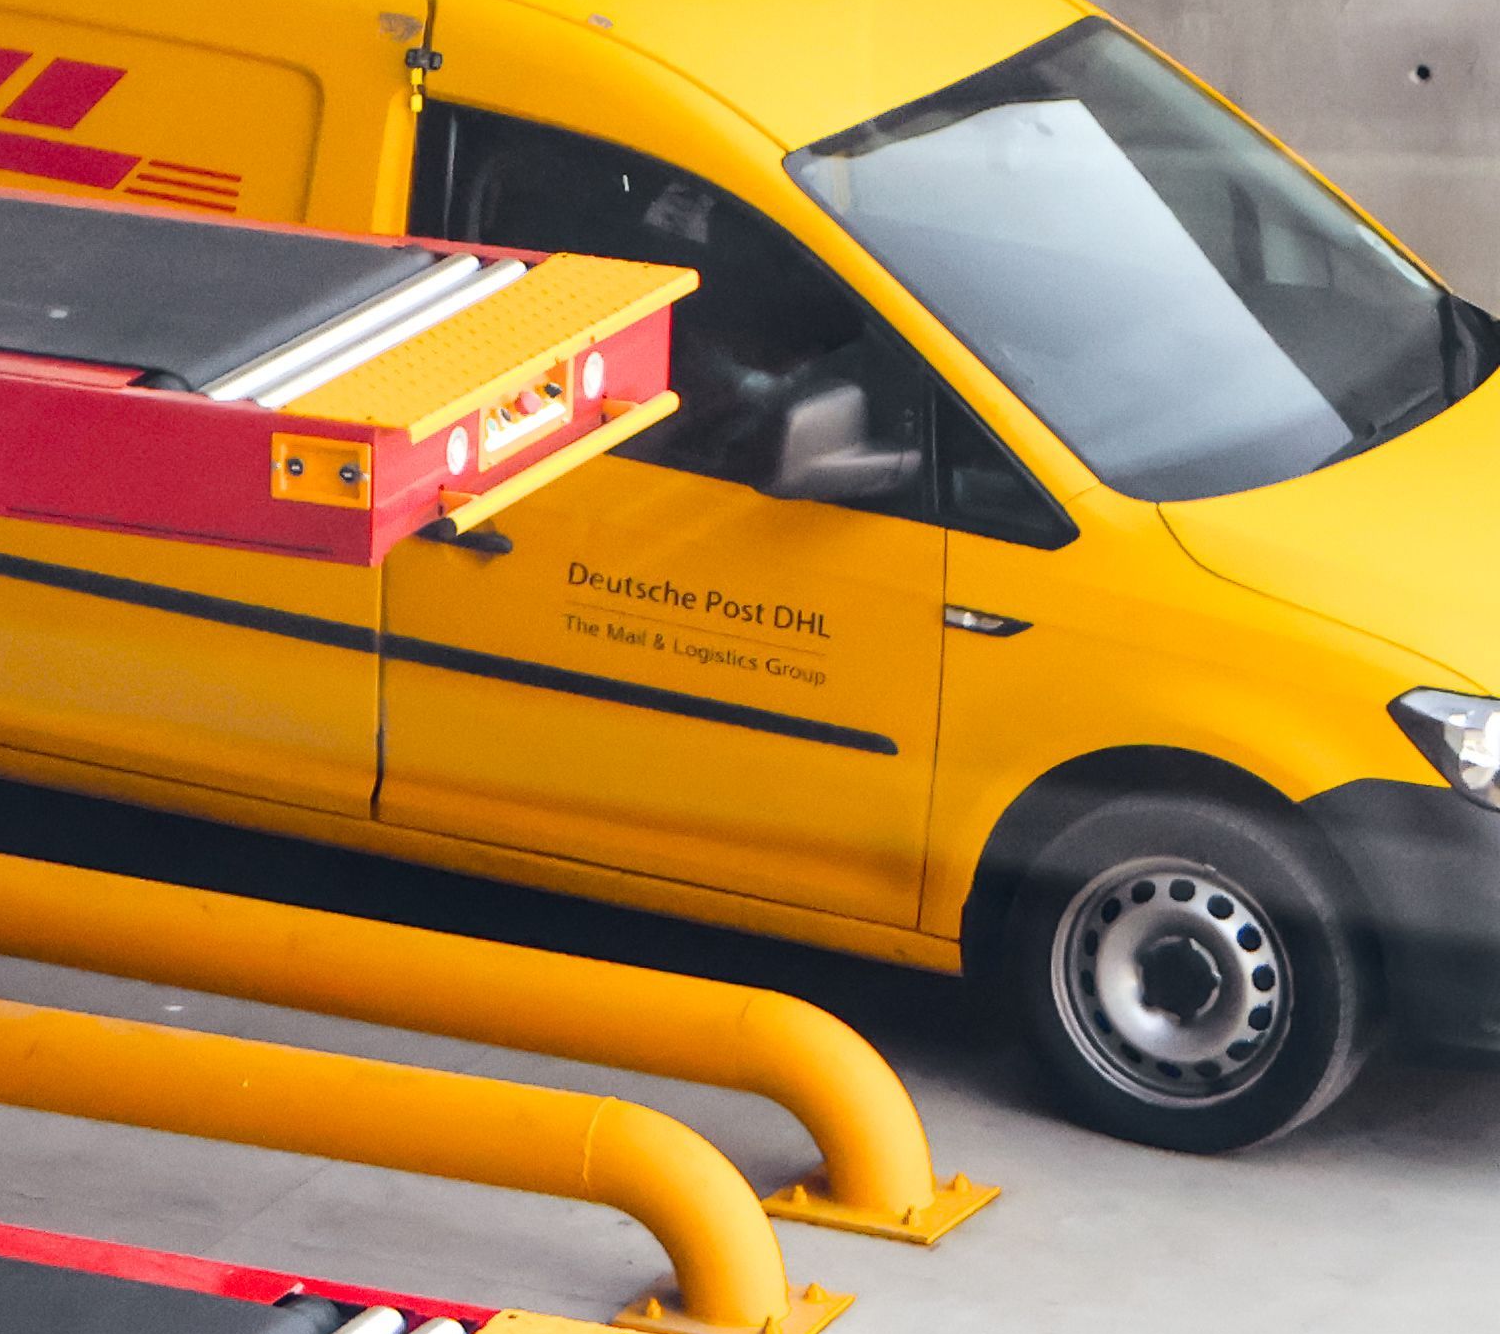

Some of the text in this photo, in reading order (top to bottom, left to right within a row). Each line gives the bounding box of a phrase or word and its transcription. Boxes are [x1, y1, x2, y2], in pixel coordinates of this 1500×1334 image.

[567, 561, 831, 639] Deutsche Post DHL
[564, 613, 827, 687] The Mail & Logistics Group
